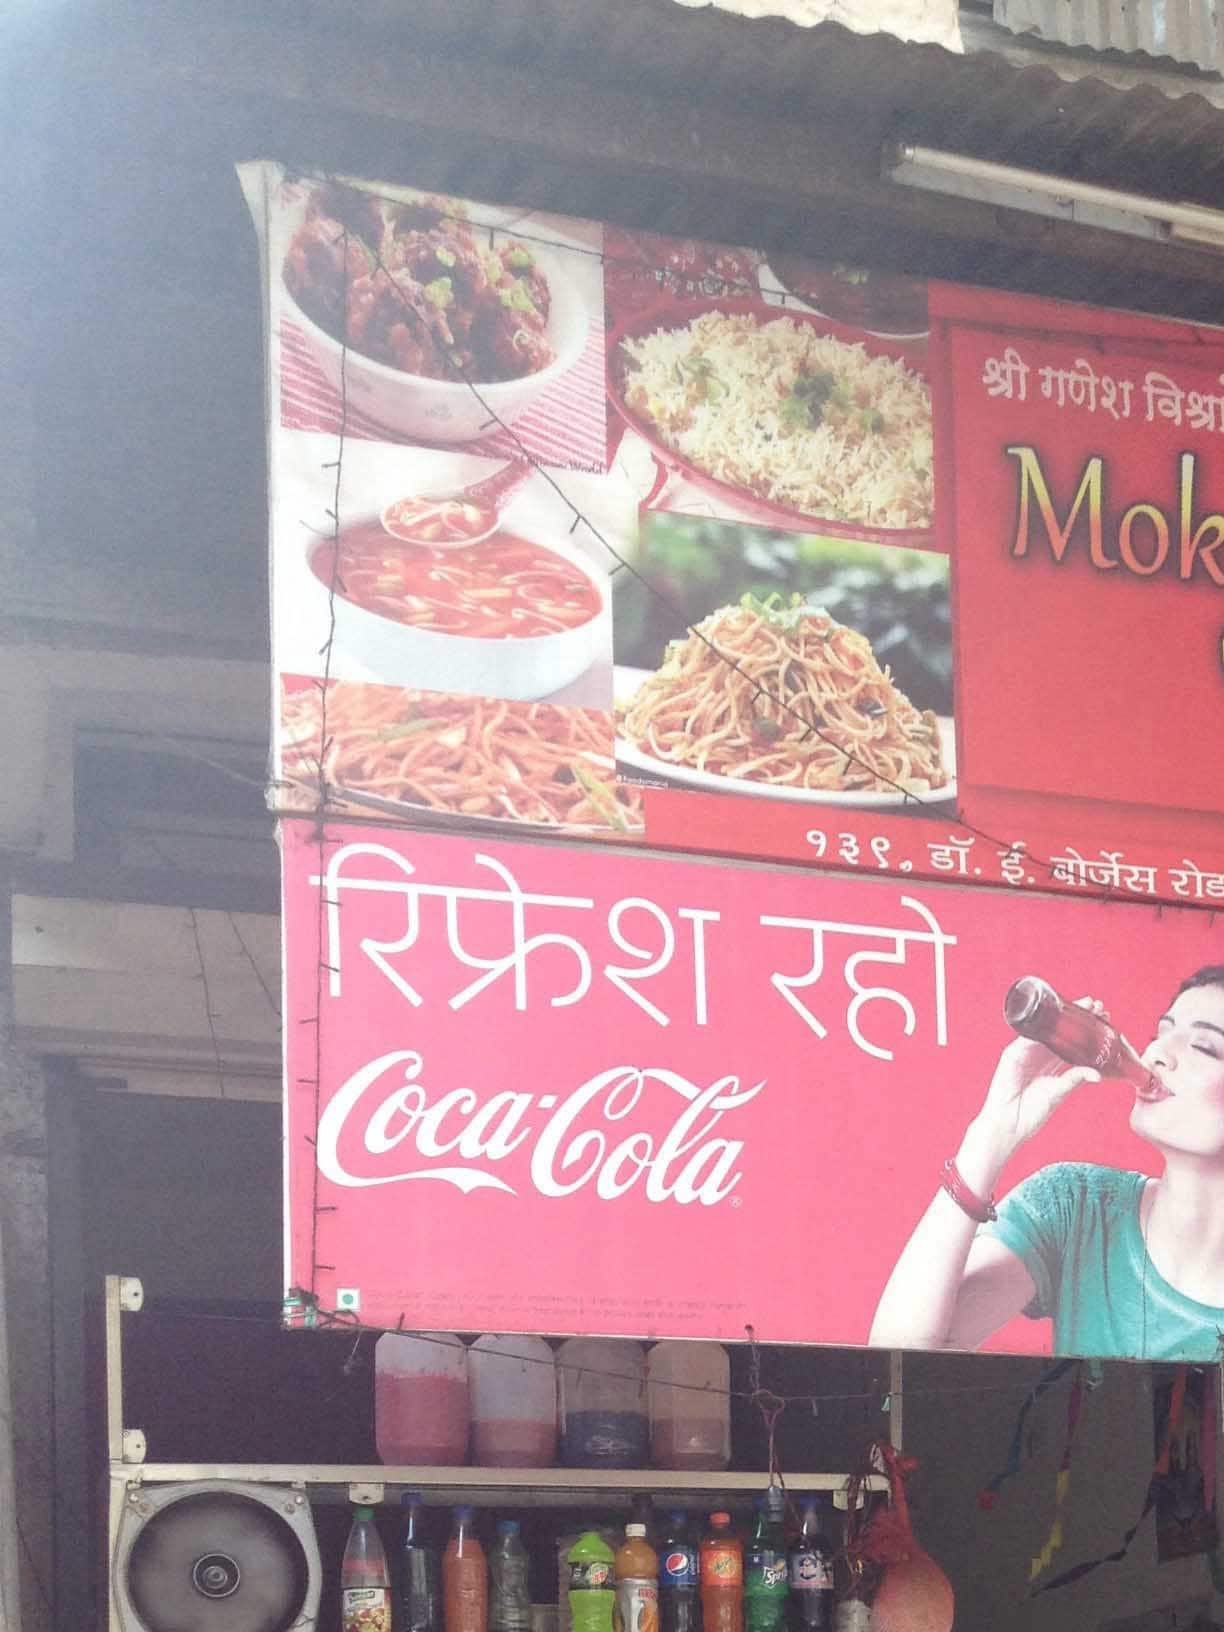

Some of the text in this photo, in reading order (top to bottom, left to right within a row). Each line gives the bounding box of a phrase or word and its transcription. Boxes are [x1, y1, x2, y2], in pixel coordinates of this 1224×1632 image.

[982, 348, 1029, 401] श्री
[1039, 359, 1133, 420] गणेश
[928, 835, 982, 876] डॉ.
[997, 841, 1035, 885] ई.
[1050, 847, 1157, 895] बोर्जेस
[310, 842, 957, 1061] रिफ्रेश रहो
[317, 1050, 767, 1205] Coca-Cola
